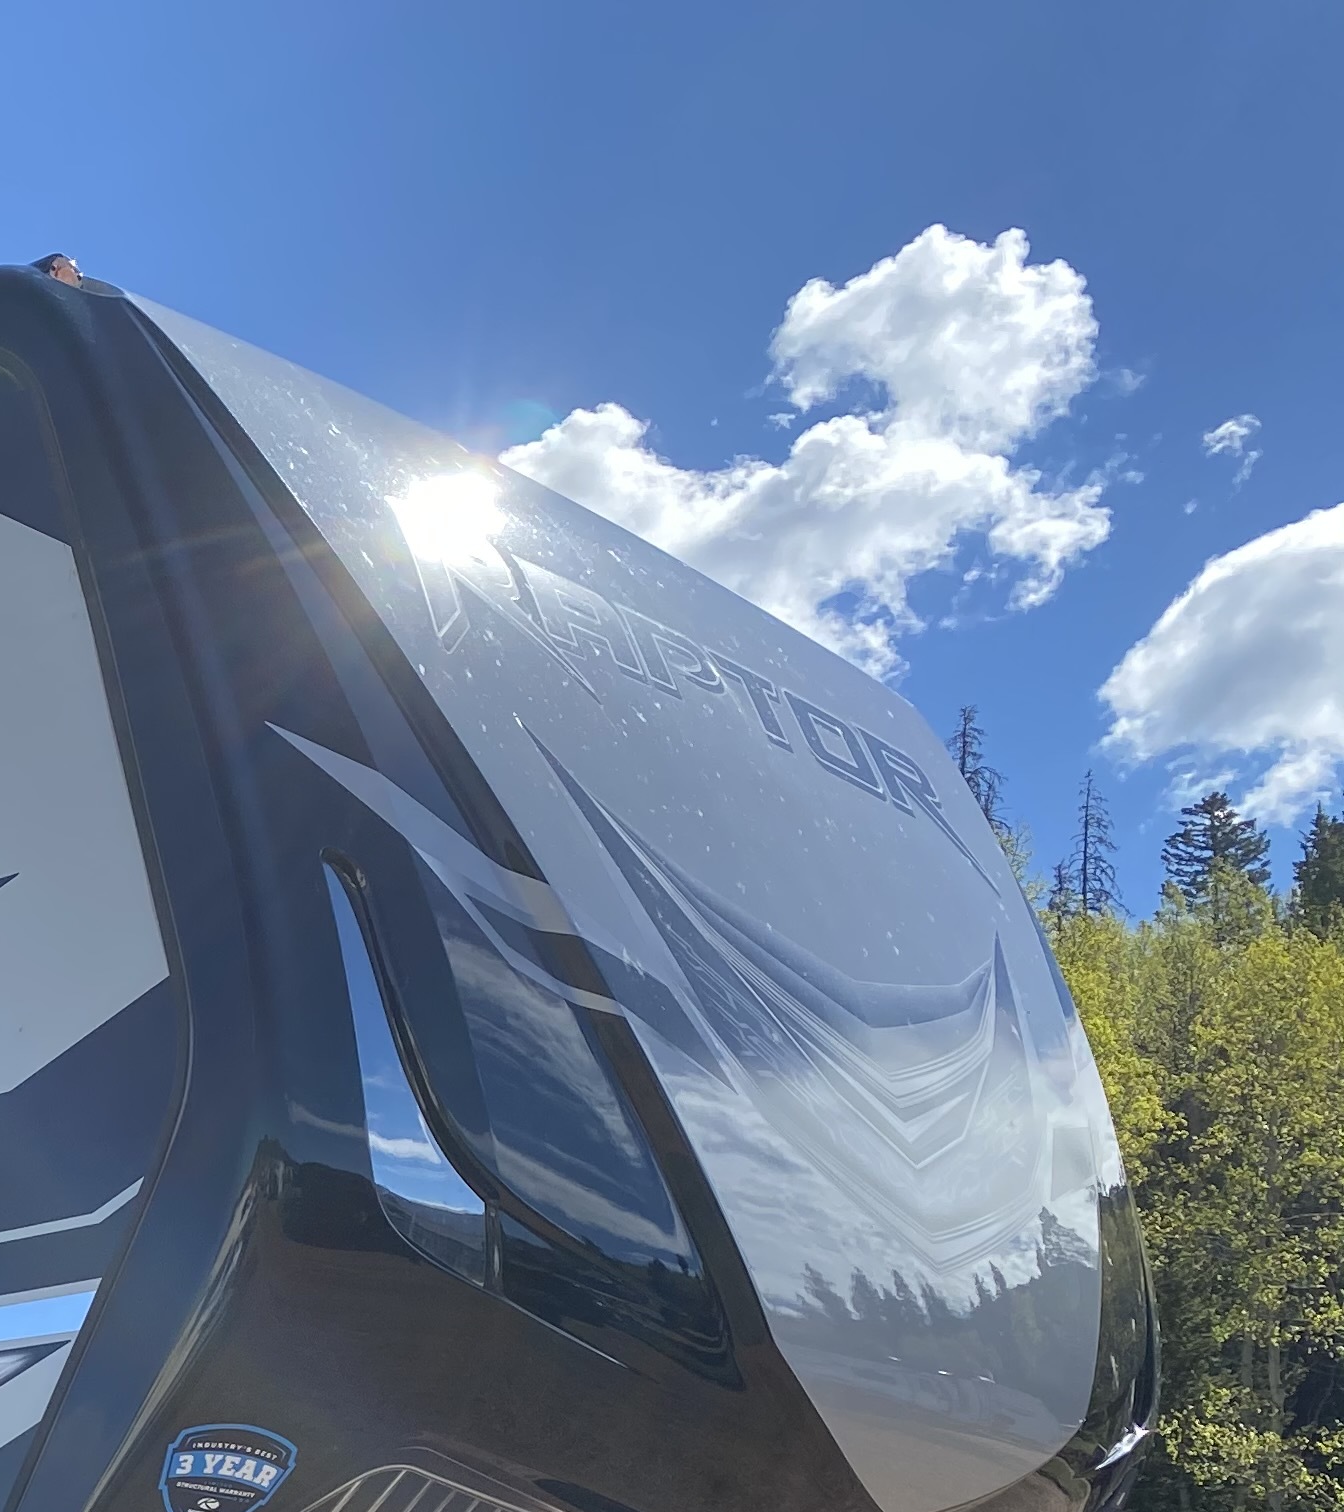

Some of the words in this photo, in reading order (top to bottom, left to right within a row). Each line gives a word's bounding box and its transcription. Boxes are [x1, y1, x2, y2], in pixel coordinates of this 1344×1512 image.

[192, 1442, 253, 1453] INDUSTRY'S
[254, 1448, 278, 1460] BEST
[175, 1454, 194, 1474] 3
[203, 1454, 278, 1488] YEAR
